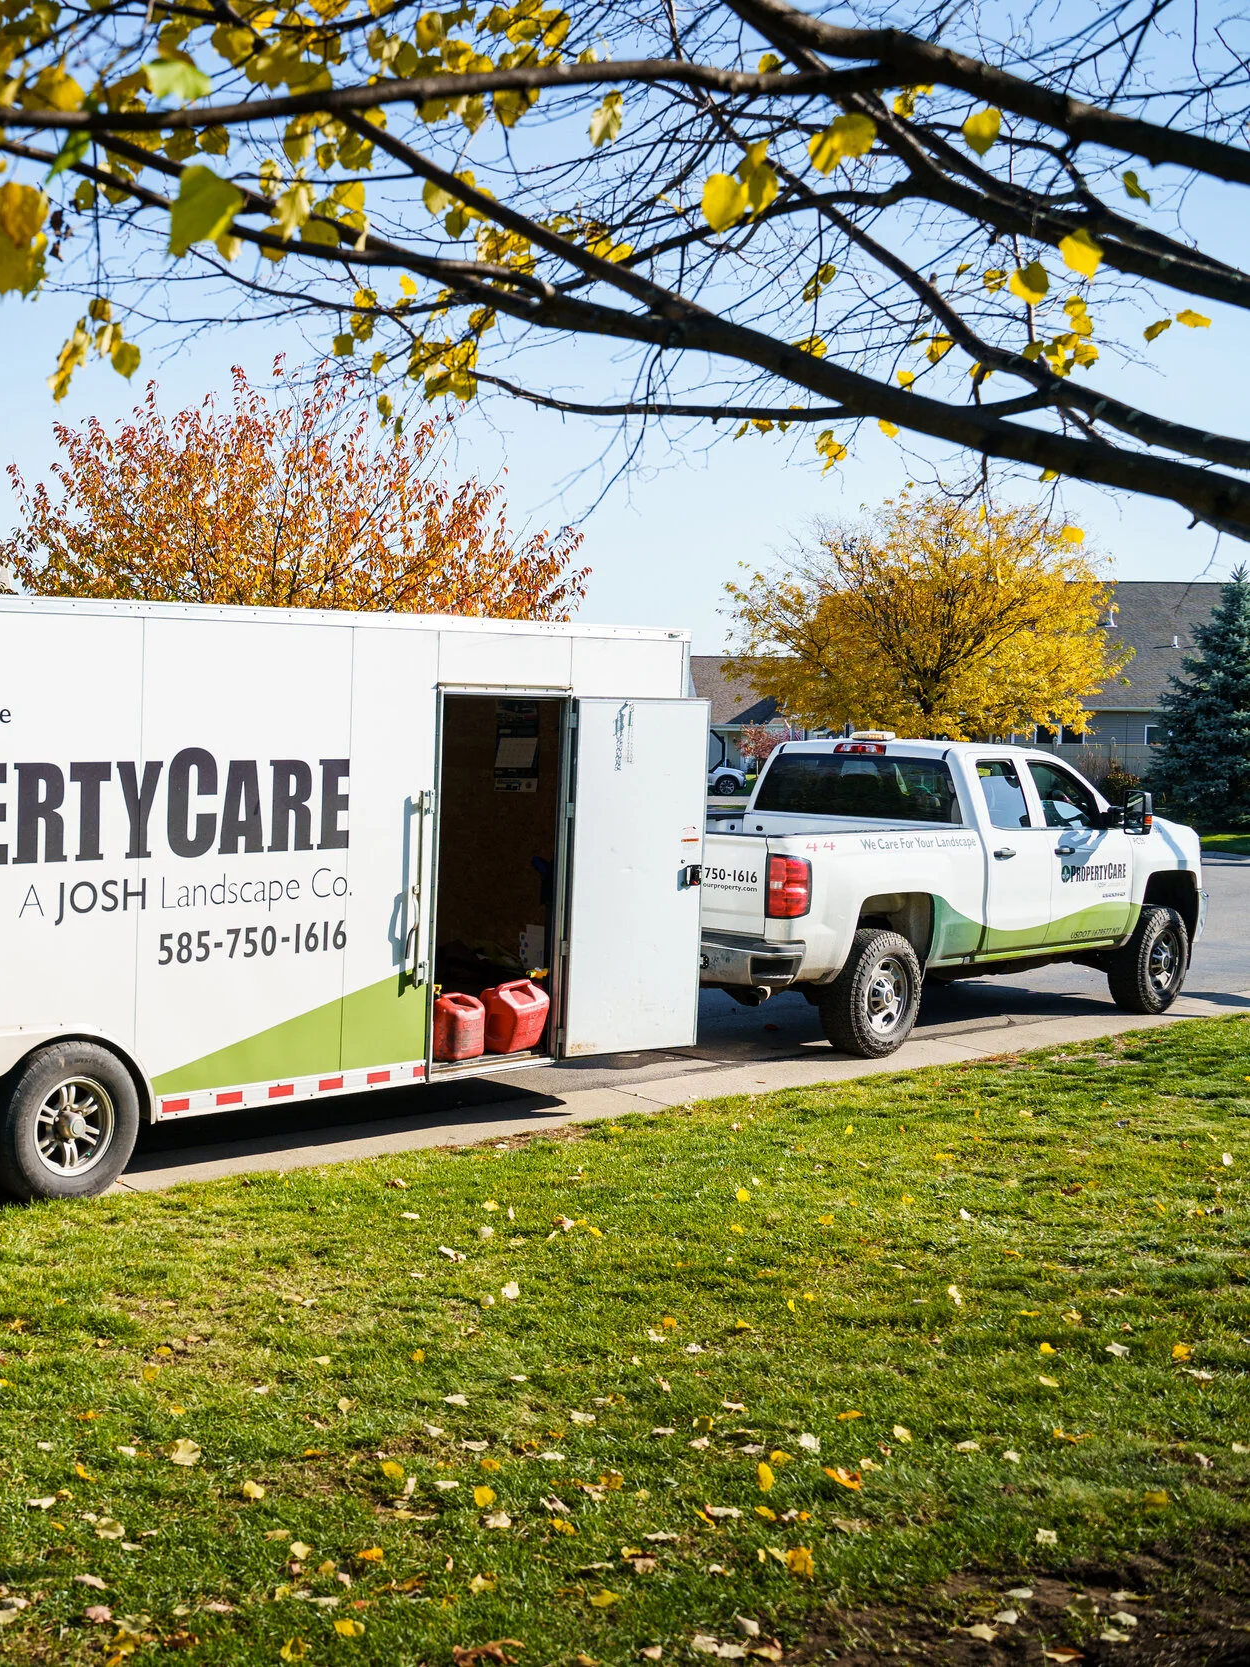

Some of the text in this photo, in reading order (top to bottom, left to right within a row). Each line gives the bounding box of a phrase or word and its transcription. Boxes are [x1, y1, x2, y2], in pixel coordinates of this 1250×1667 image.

[860, 836, 977, 850] We Care For Your Landscape
[18, 867, 353, 926] A JOSH Landscape Co.
[158, 921, 348, 966] 585-750-1616
[1070, 930, 1092, 939] USDOT
